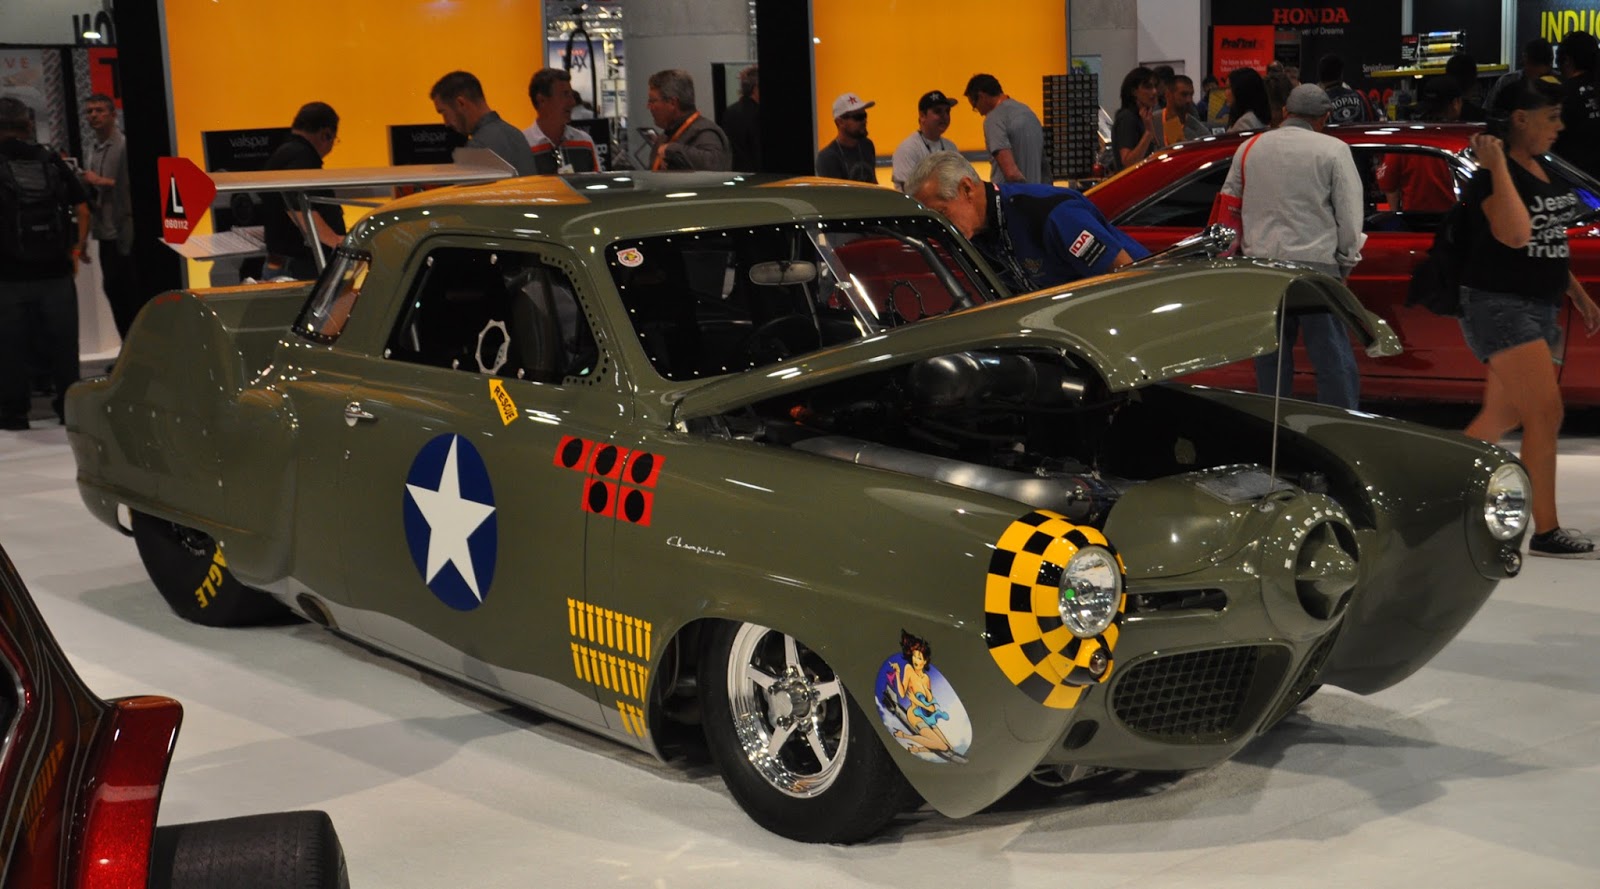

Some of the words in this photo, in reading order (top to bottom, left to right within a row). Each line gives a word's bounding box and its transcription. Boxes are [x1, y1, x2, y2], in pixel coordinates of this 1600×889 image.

[1272, 7, 1350, 25] HONDA
[1320, 27, 1344, 35] Dreams
[1071, 233, 1090, 254] IDA
[494, 386, 515, 420] RESCUE
[195, 543, 227, 608] AGLE
